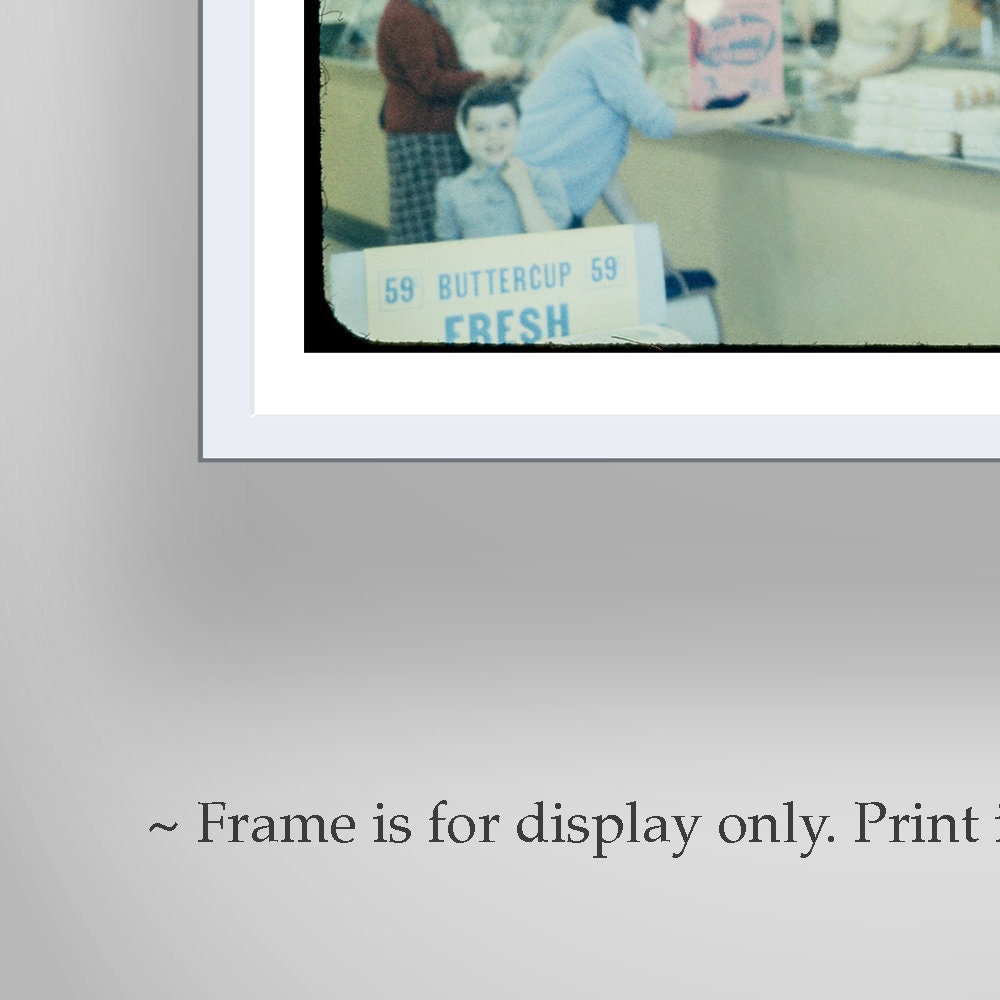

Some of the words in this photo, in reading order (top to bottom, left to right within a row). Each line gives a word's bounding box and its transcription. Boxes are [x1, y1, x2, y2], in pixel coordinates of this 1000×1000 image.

[385, 276, 415, 304] 59
[438, 261, 572, 300] BUTTERCUP
[591, 256, 618, 283] 59
[444, 303, 571, 344] FRESH
